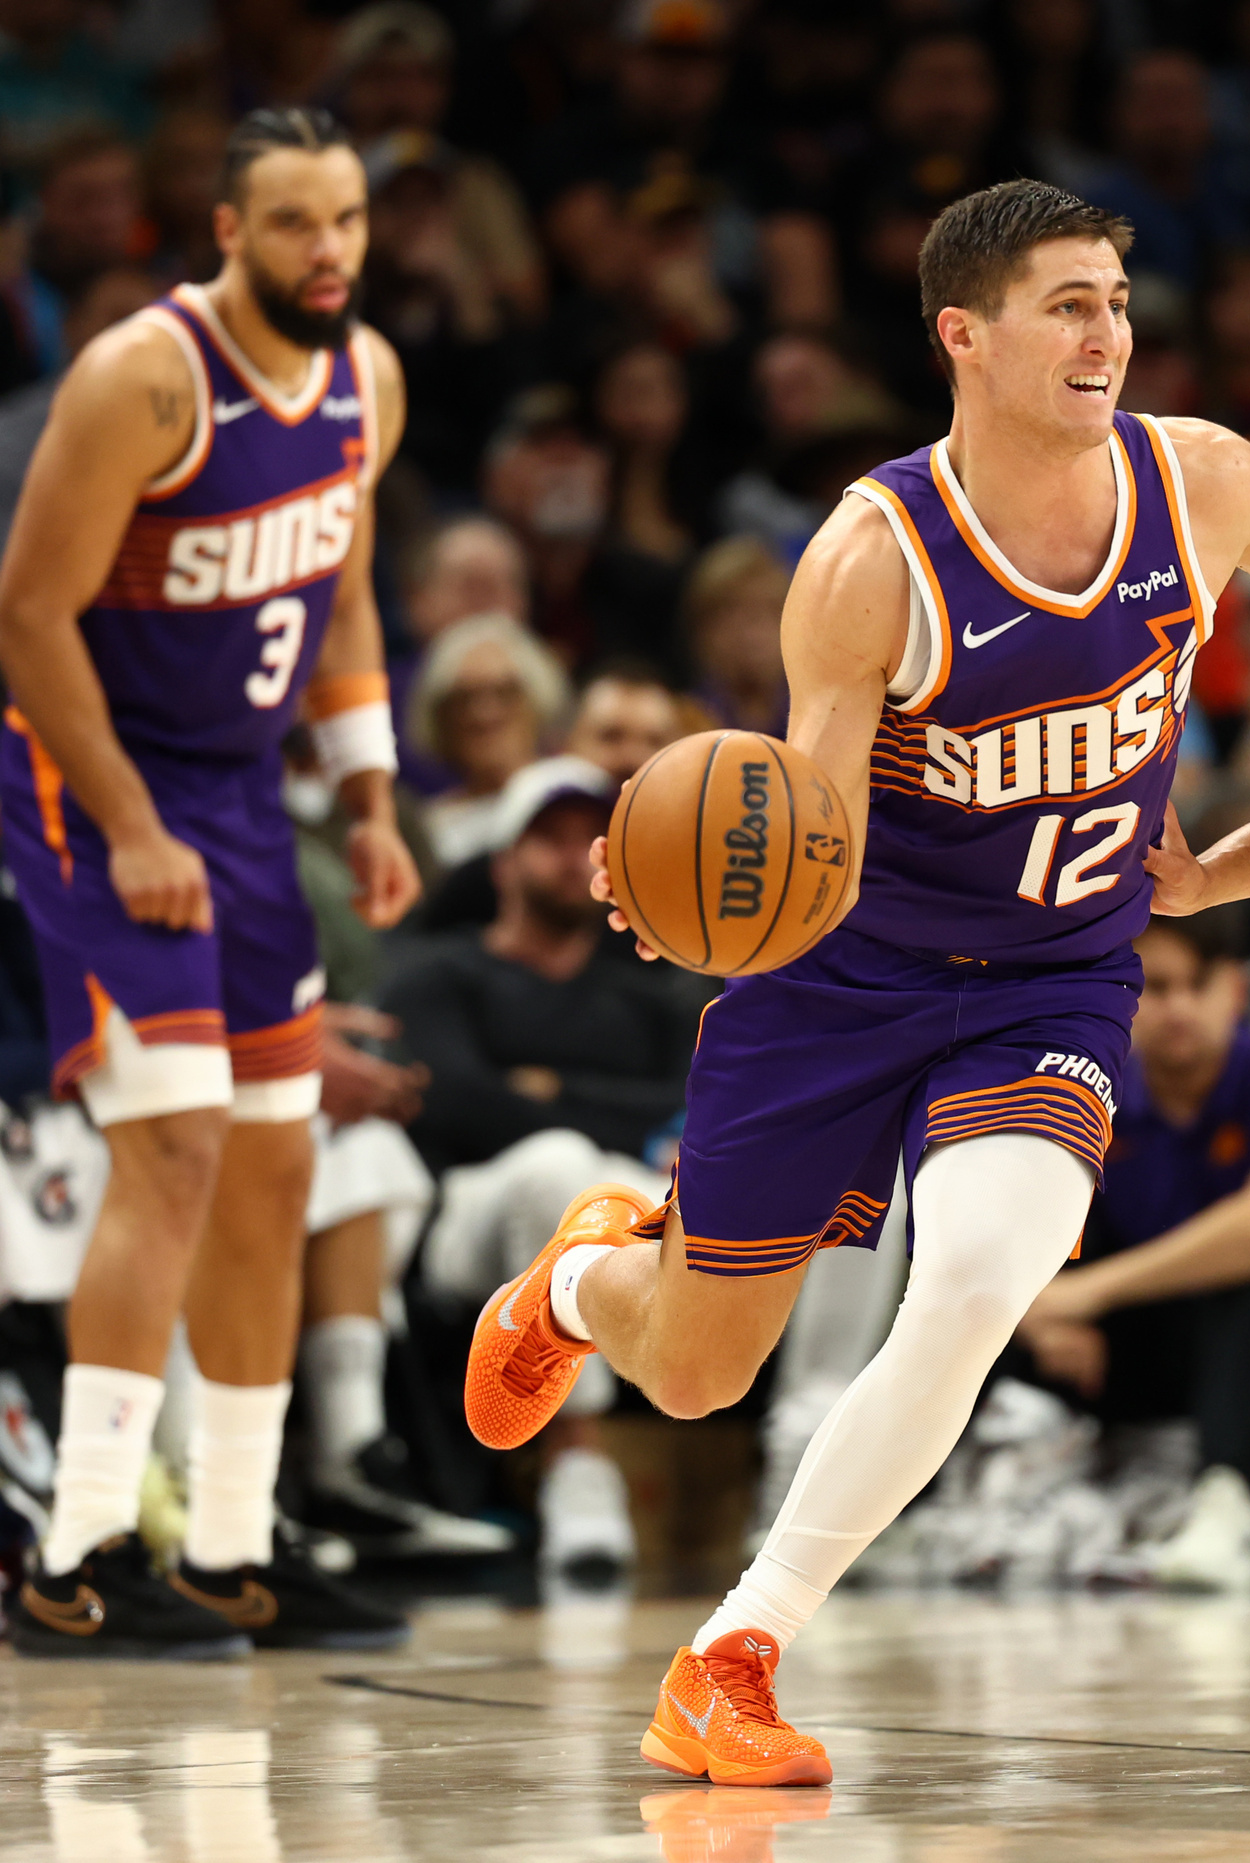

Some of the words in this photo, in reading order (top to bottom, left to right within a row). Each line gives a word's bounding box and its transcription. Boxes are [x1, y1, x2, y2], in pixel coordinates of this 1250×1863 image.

[161, 480, 356, 605] SUNS
[1116, 564, 1179, 603] PayPal
[245, 596, 306, 708] 3
[923, 668, 1166, 808] SUNS
[717, 761, 771, 921] Wilson
[1017, 801, 1141, 907] 12
